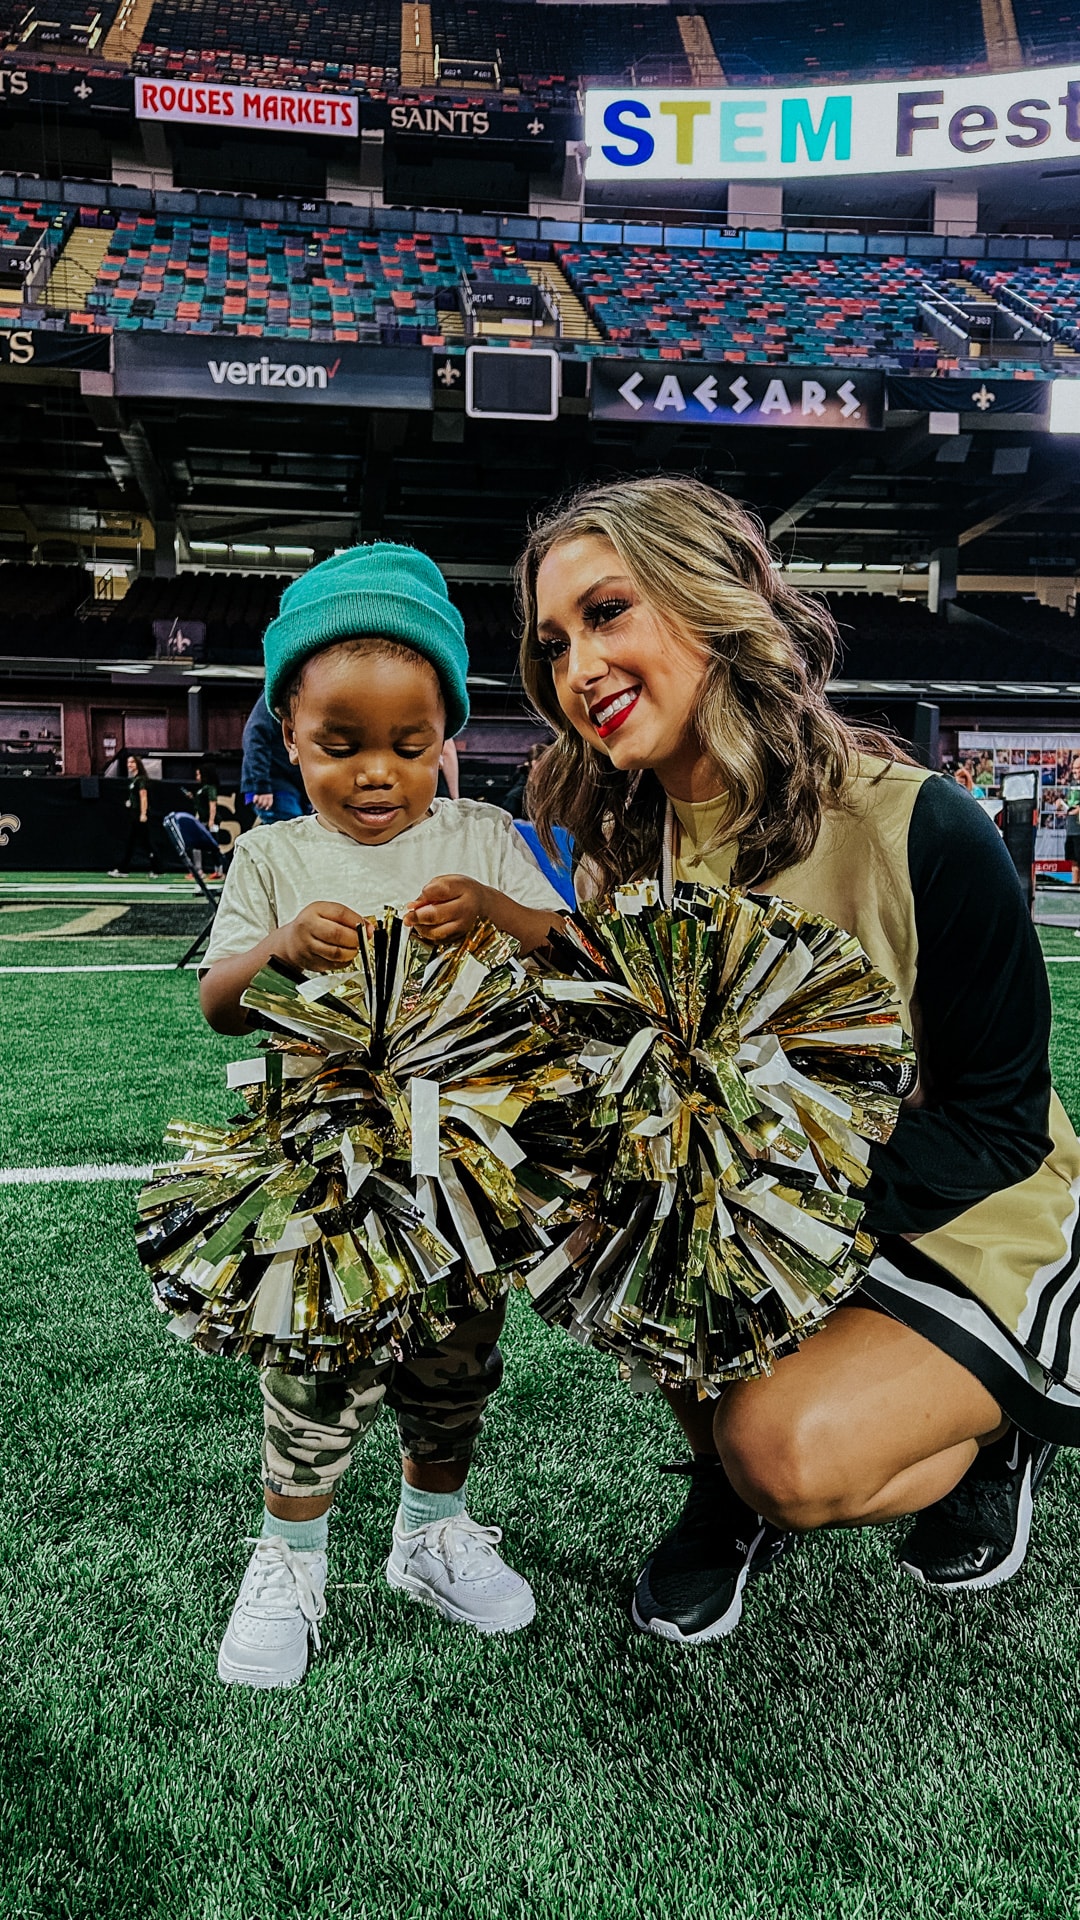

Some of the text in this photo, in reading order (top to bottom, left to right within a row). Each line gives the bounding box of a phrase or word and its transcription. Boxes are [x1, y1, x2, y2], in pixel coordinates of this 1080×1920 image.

[142, 84, 353, 126] ROUSES MARKETS
[390, 106, 490, 134] SAINTS
[601, 95, 852, 167] STEM
[208, 356, 328, 389] verizon
